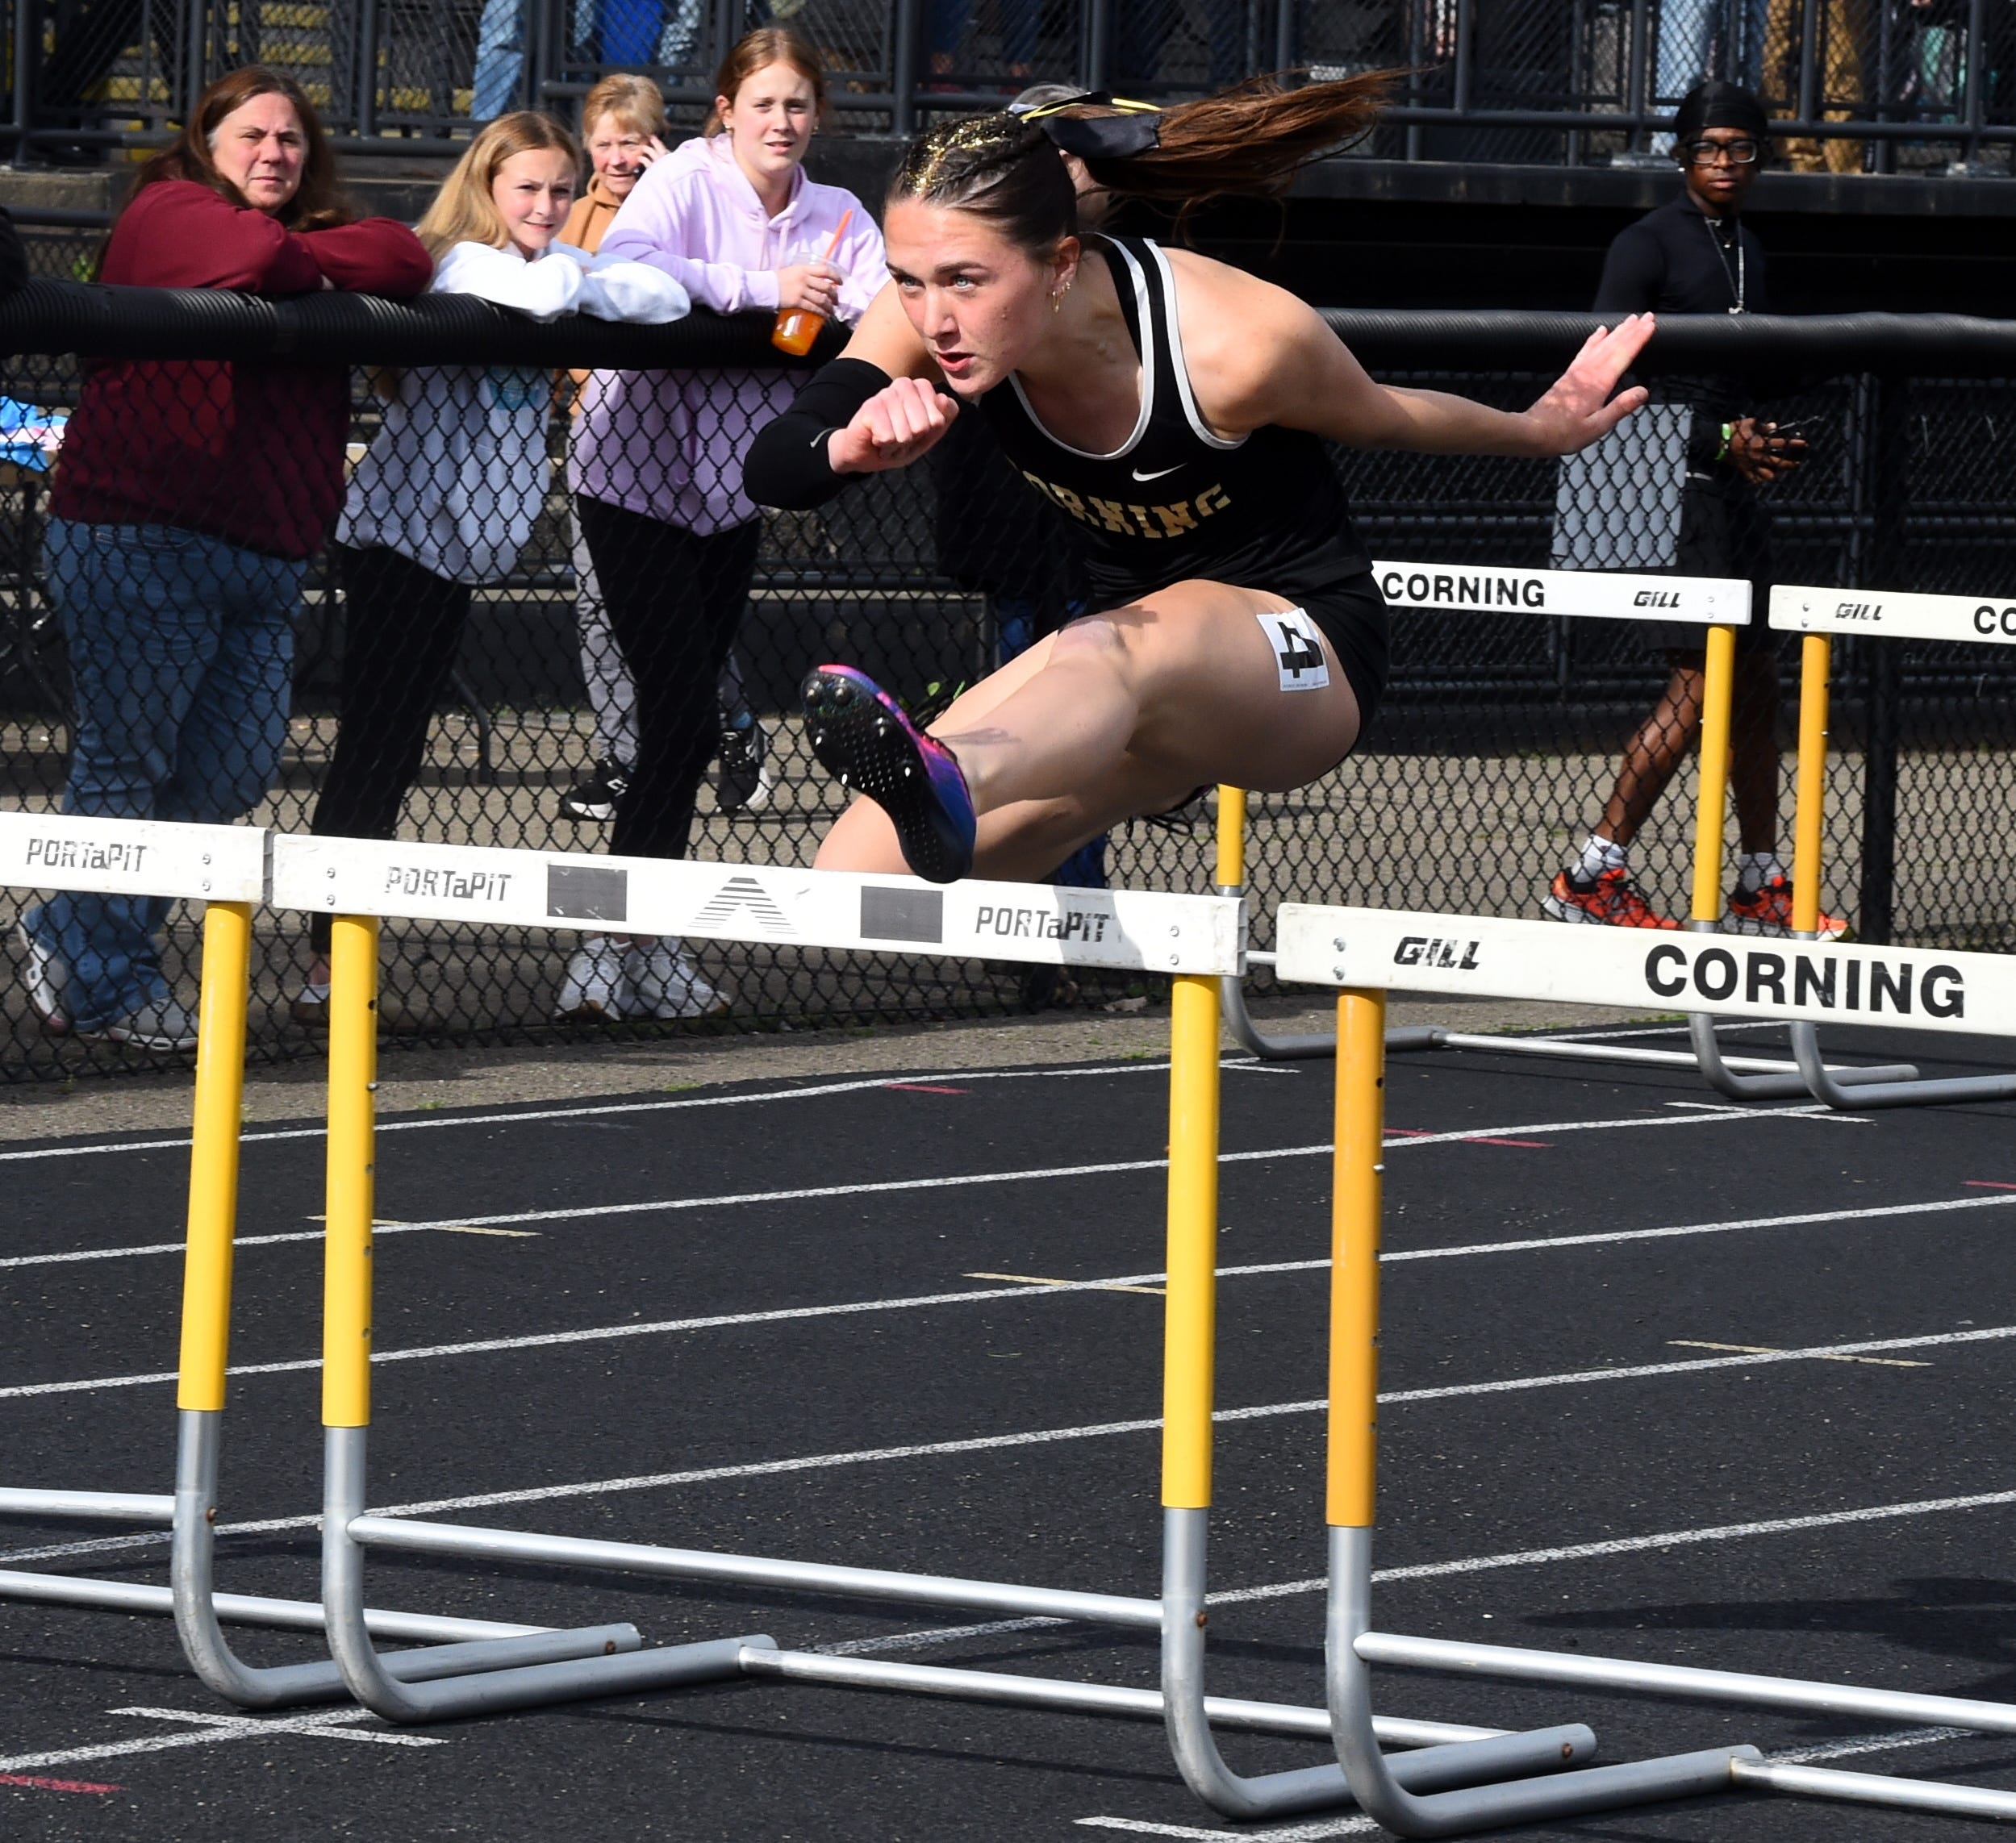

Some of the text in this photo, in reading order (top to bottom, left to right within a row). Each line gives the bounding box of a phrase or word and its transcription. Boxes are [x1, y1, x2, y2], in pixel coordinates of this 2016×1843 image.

[1006, 456, 1232, 539] ORNING
[1381, 571, 1682, 608] CORNING GILL
[1834, 602, 1884, 621] GILL
[1393, 936, 1966, 1019] GILL CORNING
